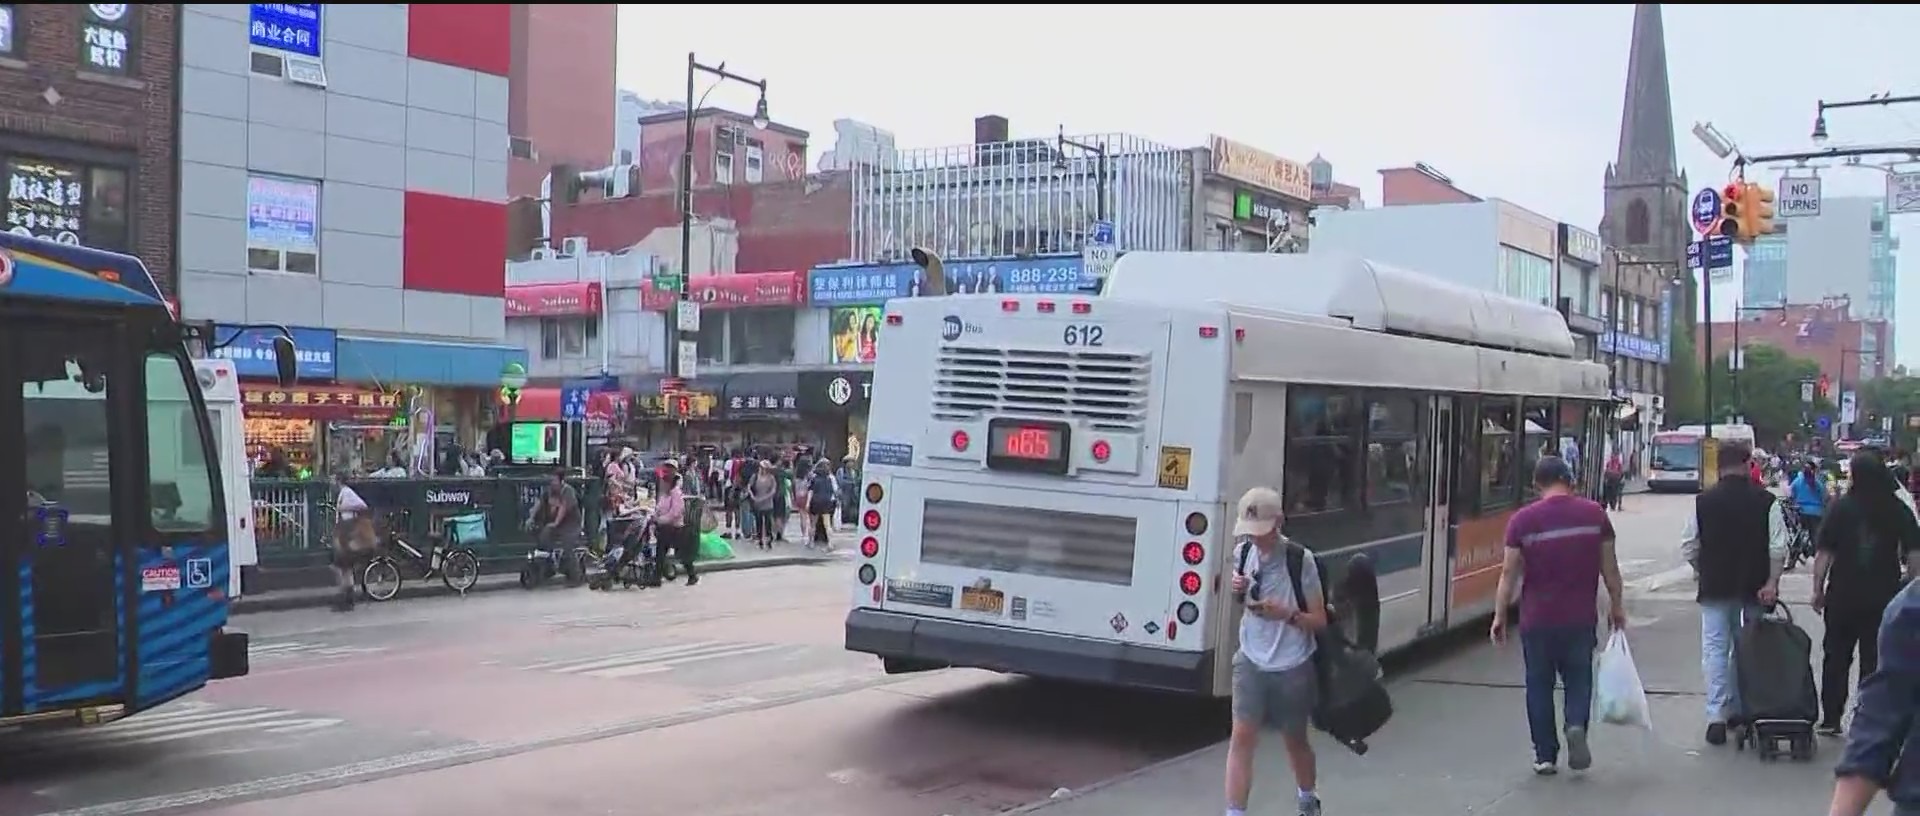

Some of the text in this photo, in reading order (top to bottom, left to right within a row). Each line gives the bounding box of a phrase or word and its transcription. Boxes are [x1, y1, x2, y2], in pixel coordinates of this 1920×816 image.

[251, 20, 311, 47] 商业合同
[1791, 184, 1808, 195] NO
[1782, 199, 1817, 210] TURNS
[1091, 249, 1107, 260] NO
[1010, 267, 1078, 283] 888-235
[756, 281, 791, 296] Salon
[965, 323, 983, 334] Bus
[1063, 325, 1103, 347] 612
[426, 489, 470, 504] Subway
[142, 568, 178, 577] CAUTION
